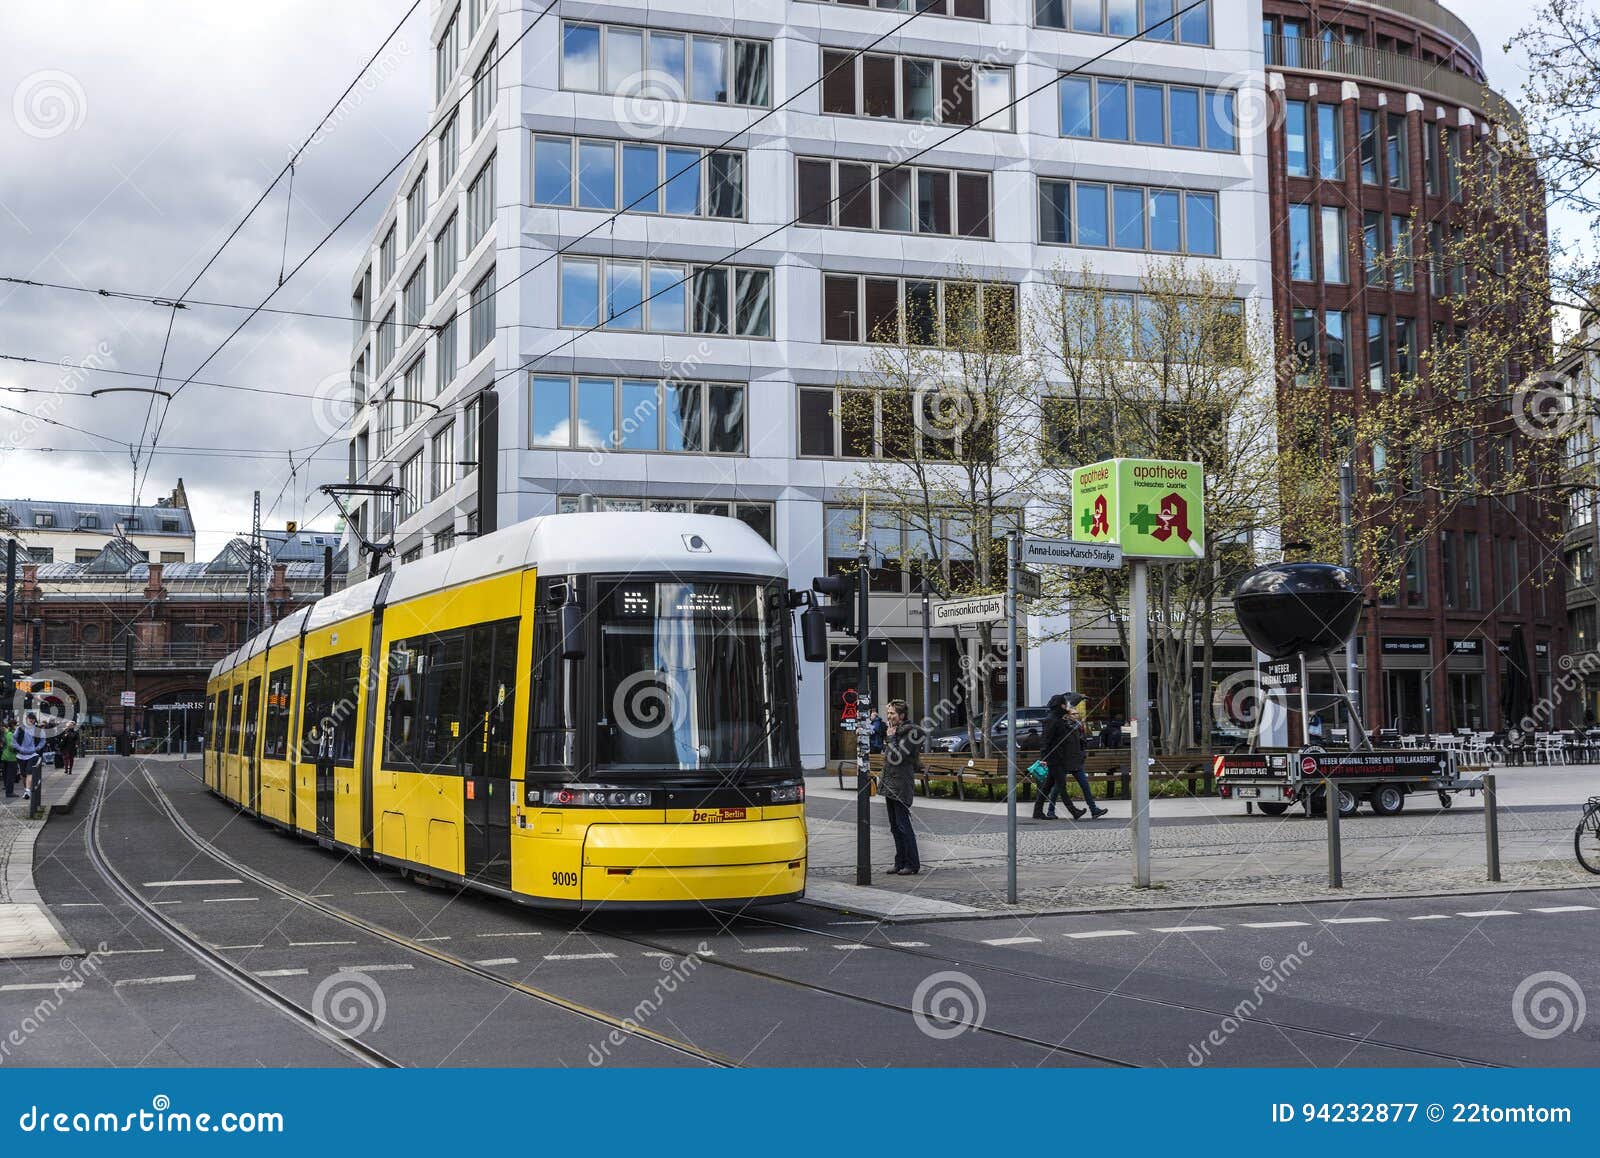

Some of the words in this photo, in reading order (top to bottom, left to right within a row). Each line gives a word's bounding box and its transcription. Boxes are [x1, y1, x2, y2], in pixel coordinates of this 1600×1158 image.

[1080, 467, 1109, 486] apotheke
[1134, 465, 1188, 480] apotheke
[937, 601, 1001, 618] Garnisonkirchplatz
[1275, 663, 1289, 673] WEBER
[1320, 757, 1338, 765] WEBER
[1339, 756, 1363, 765] ORIGINAL
[1365, 756, 1381, 764] STORE
[1395, 755, 1436, 764] GRILLAKADEMIE
[692, 809, 708, 822] be
[724, 811, 745, 819] Berlin
[551, 872, 578, 887] 9009
